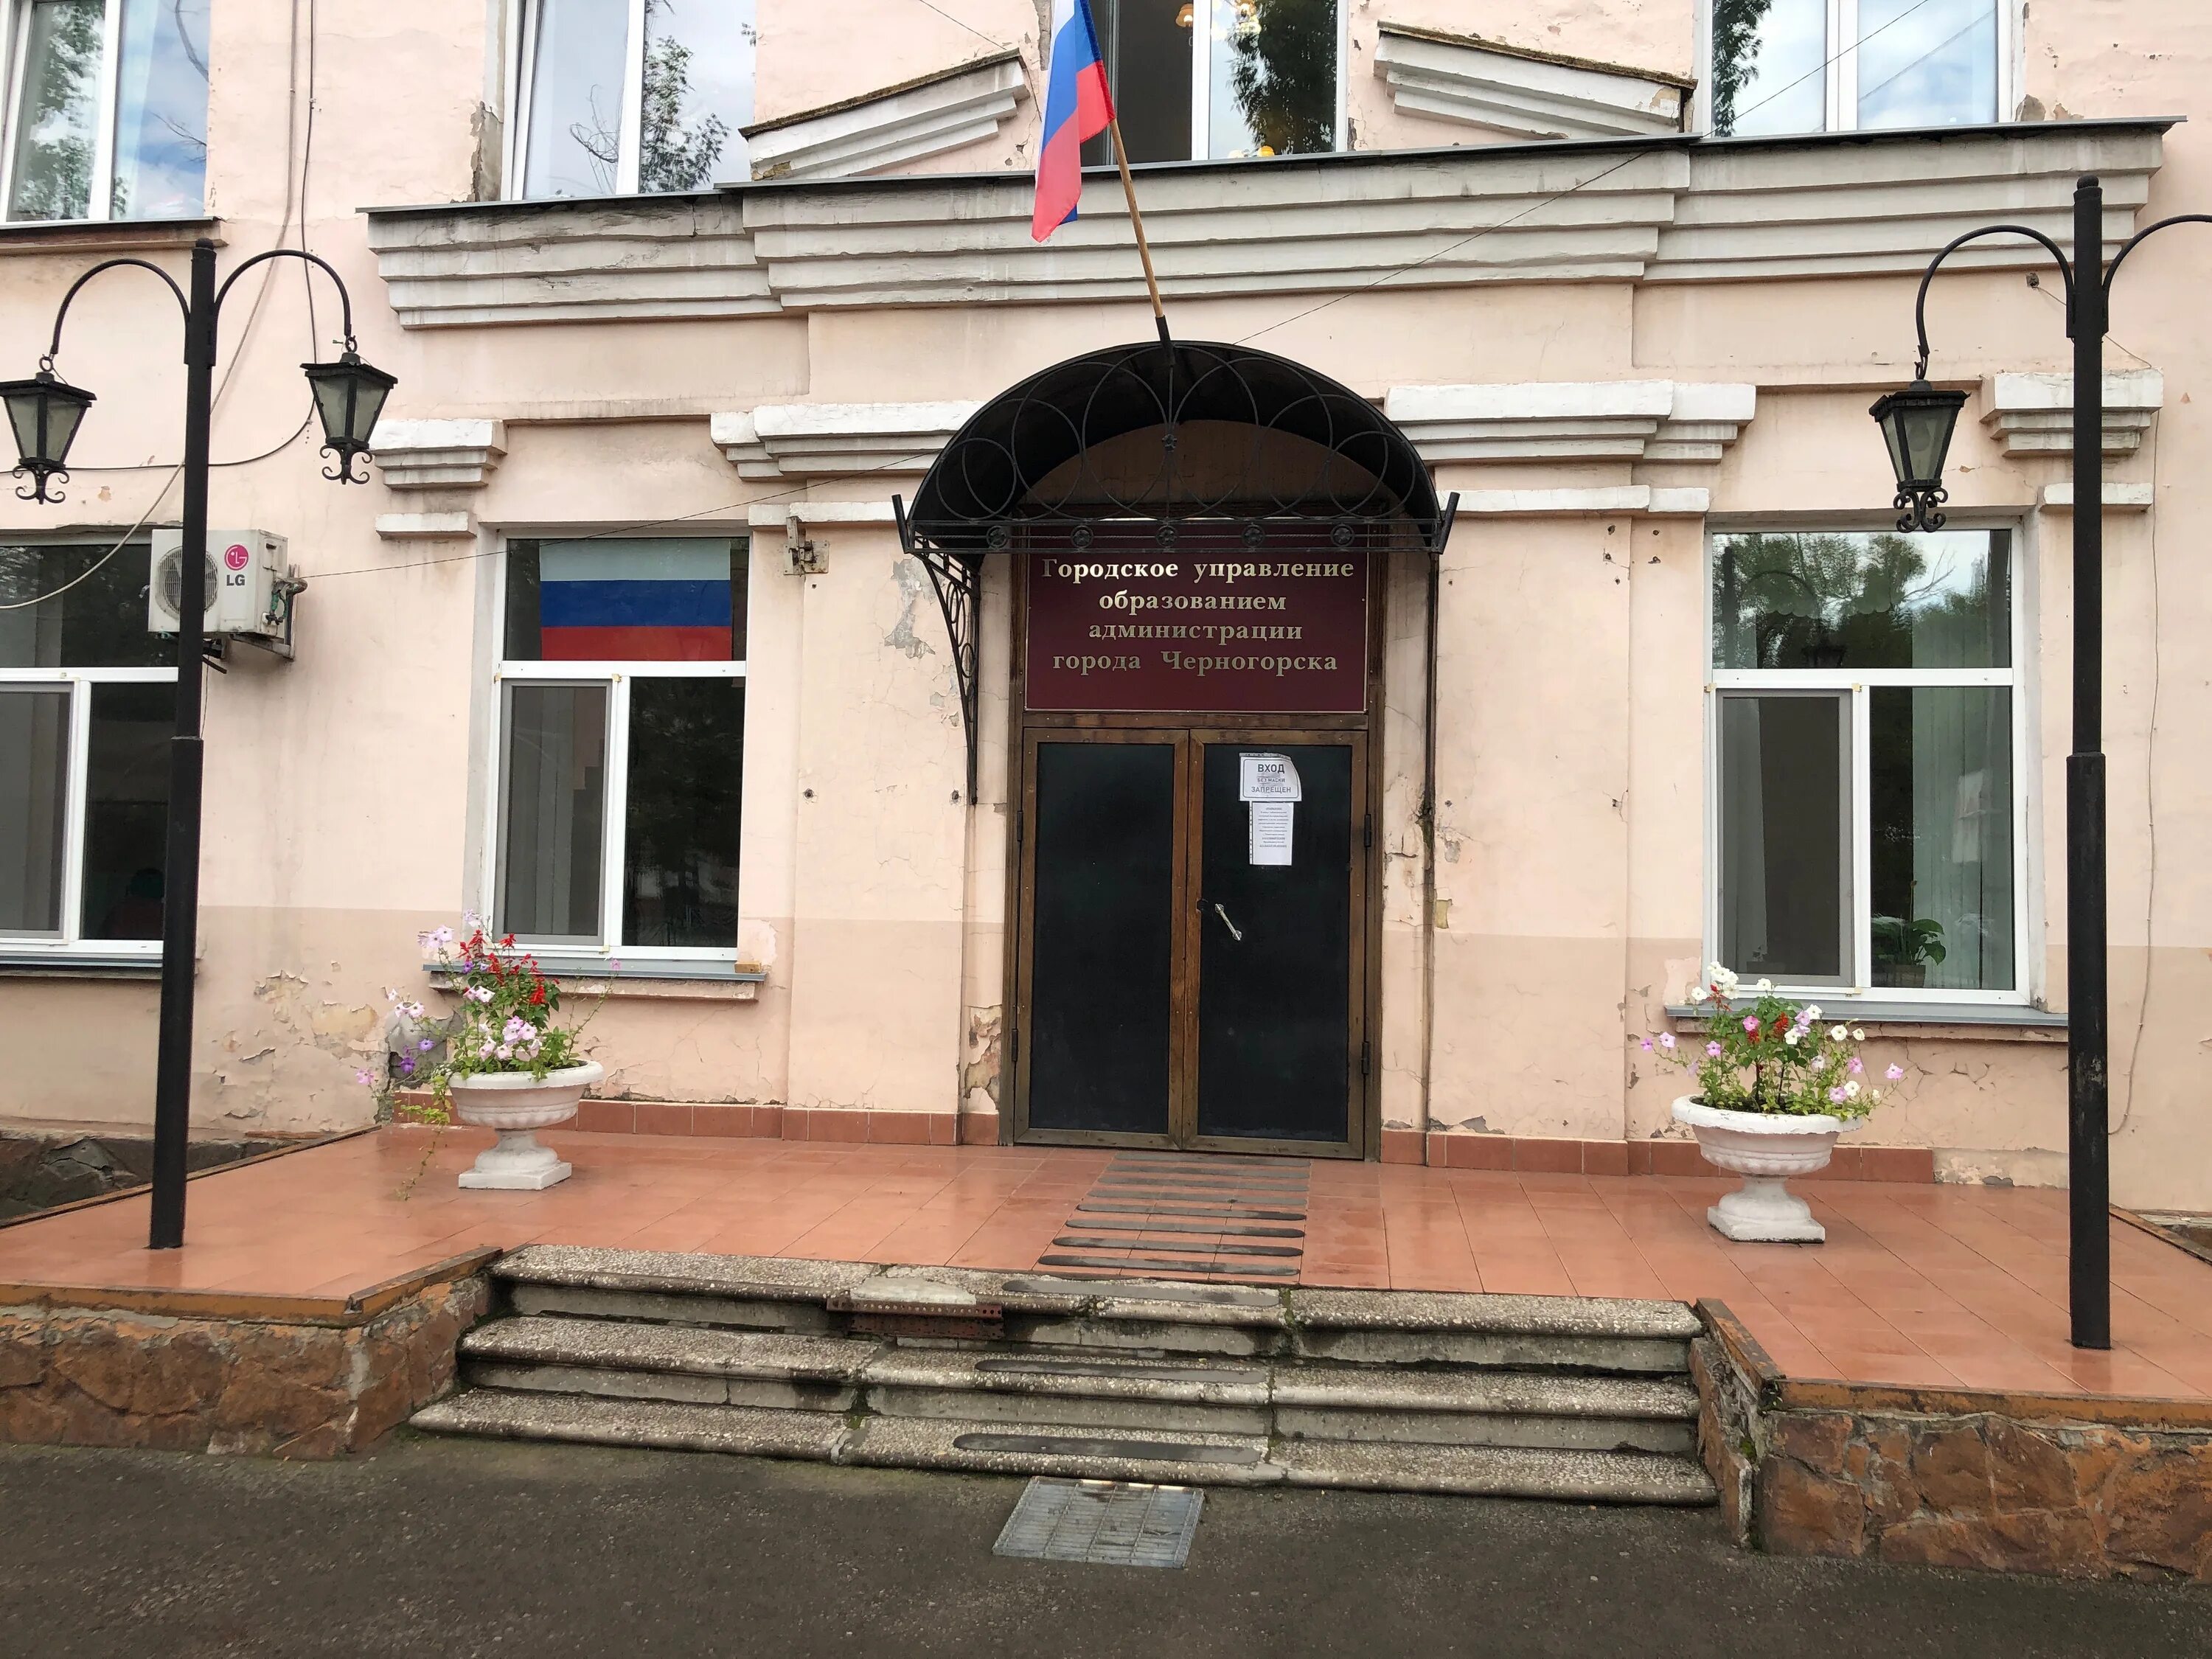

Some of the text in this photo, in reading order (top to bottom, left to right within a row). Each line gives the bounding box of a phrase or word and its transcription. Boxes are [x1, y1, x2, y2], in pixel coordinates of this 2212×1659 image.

[226, 574, 245, 586] LG
[1042, 558, 1354, 583] Городское управление
[1099, 589, 1287, 616] образованием
[1088, 624, 1303, 646] администрации
[1052, 650, 1338, 677] города Черногорска
[1257, 764, 1284, 773] ВХОД
[1251, 786, 1291, 794] ЗАПРЕЩЕН
